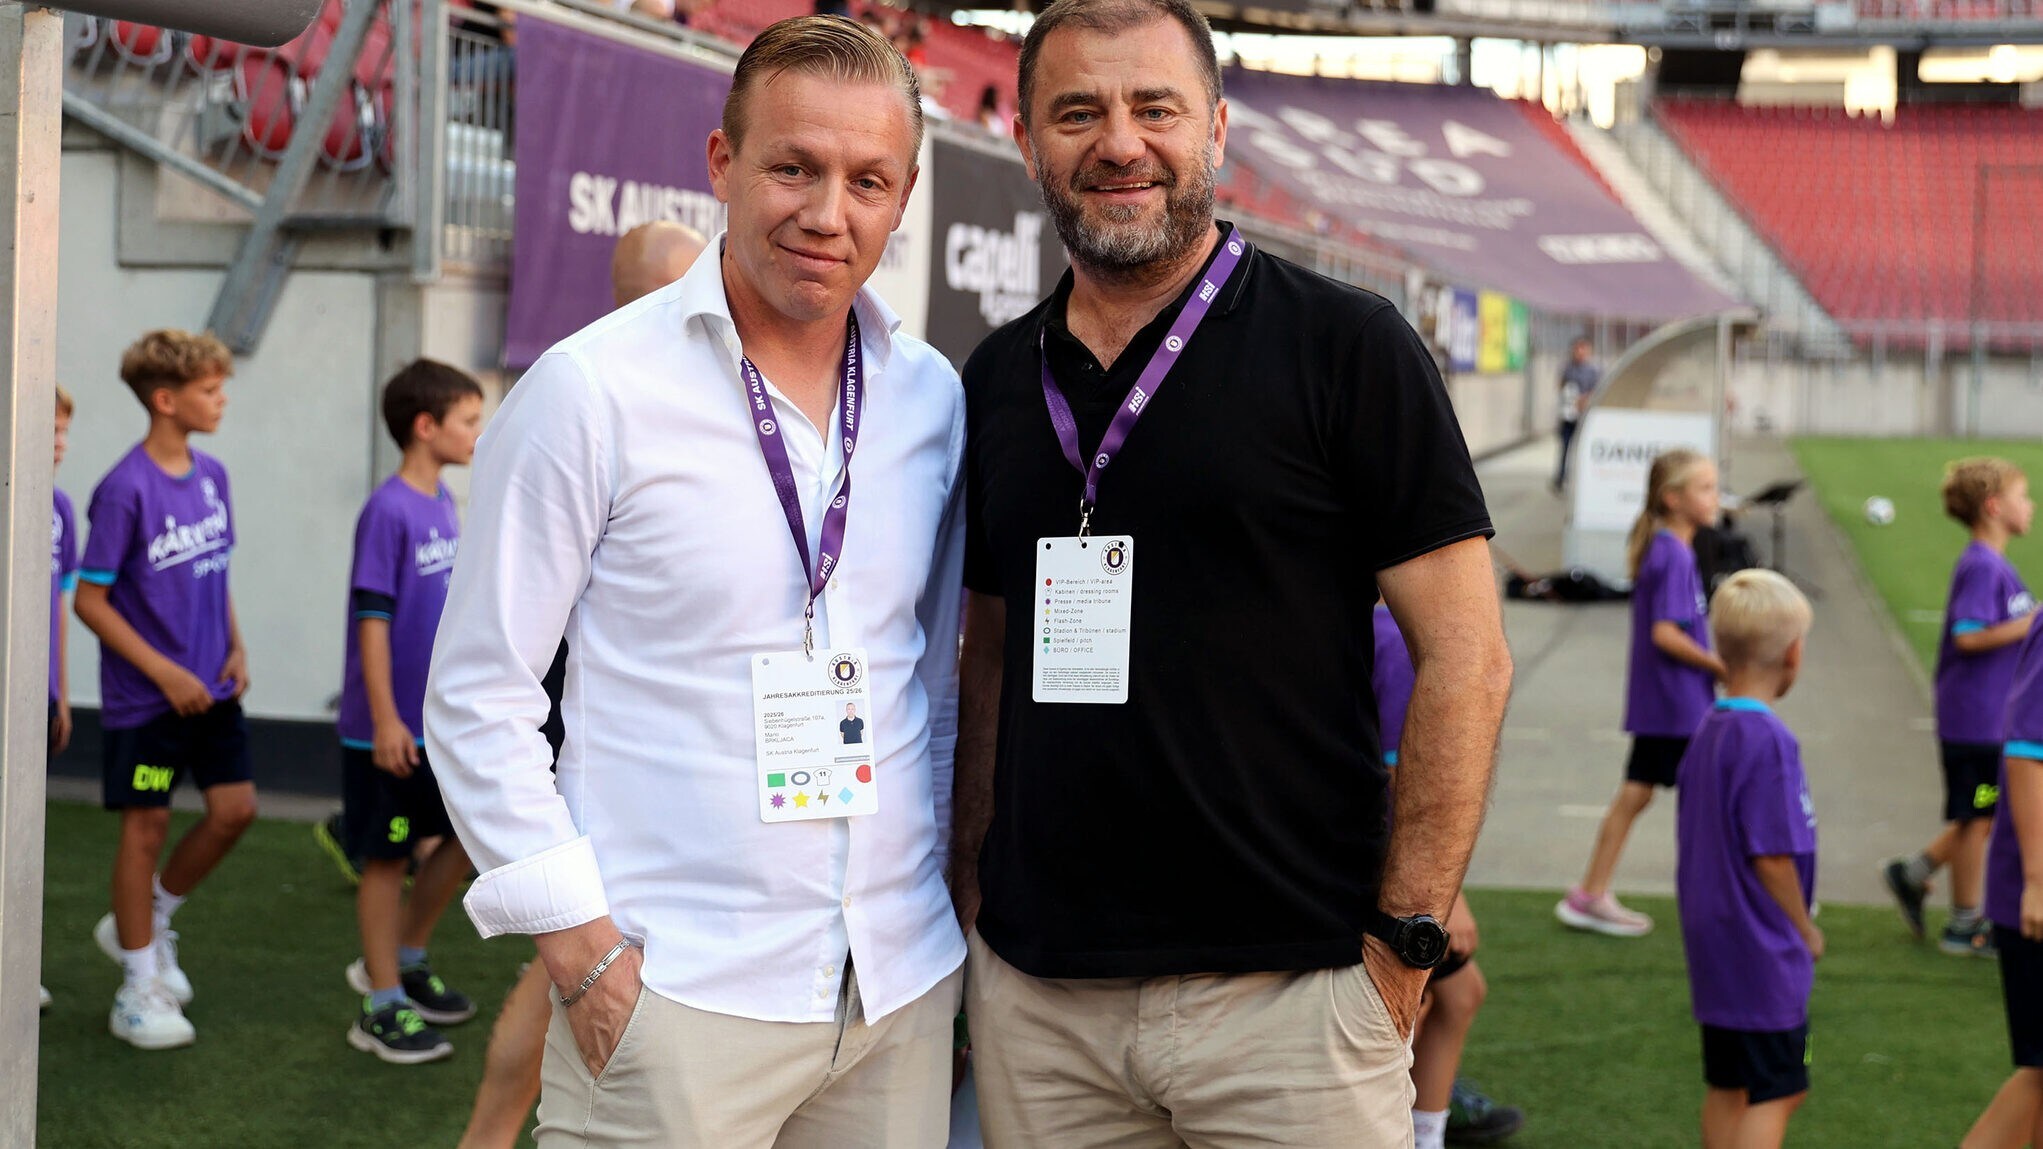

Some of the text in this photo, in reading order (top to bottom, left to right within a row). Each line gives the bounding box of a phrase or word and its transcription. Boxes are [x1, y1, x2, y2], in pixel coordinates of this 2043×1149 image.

[568, 171, 618, 237] SK
[754, 395, 766, 411] SK
[844, 366, 857, 432] KLAGENFURT
[762, 689, 845, 700] JAHRESAKKREDITIERUNG
